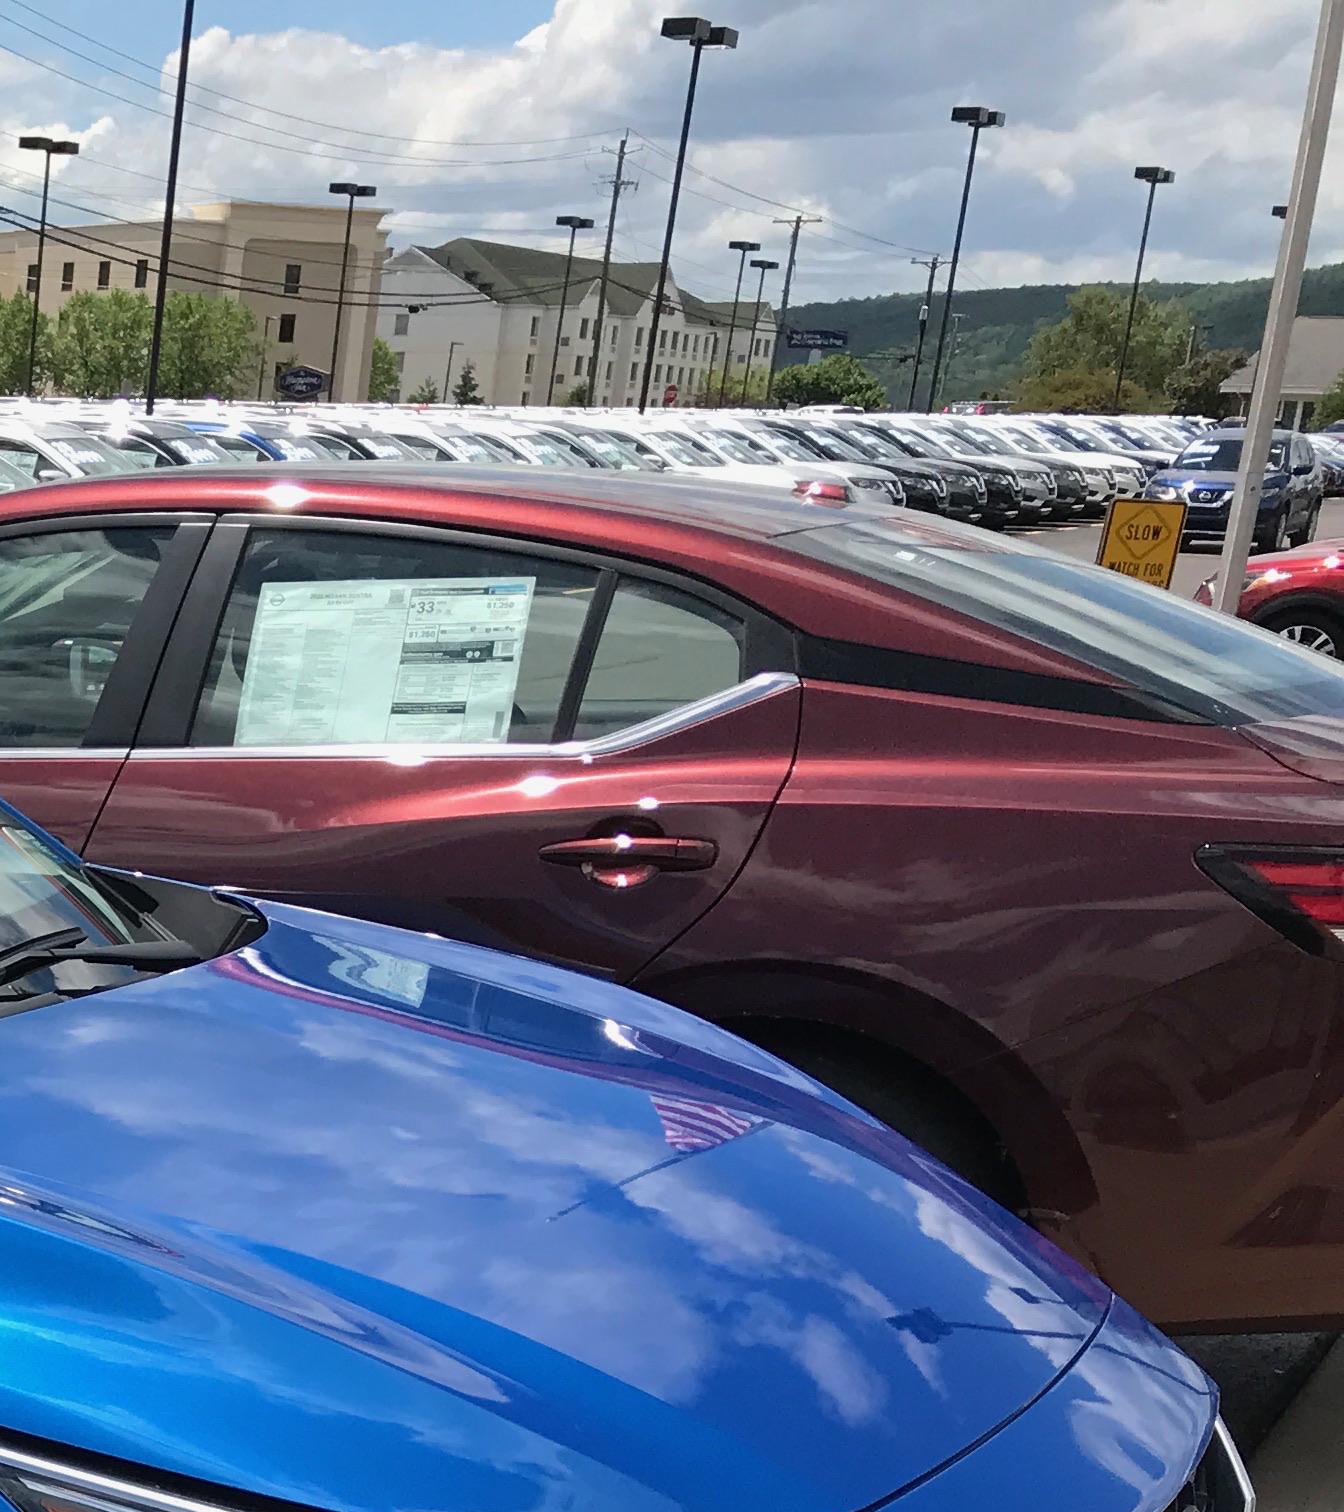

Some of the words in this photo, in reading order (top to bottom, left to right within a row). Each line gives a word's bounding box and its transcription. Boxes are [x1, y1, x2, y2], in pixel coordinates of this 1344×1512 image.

[1125, 523, 1163, 541] SLOW
[1143, 562, 1164, 577] FOR
[417, 601, 435, 614] 33
